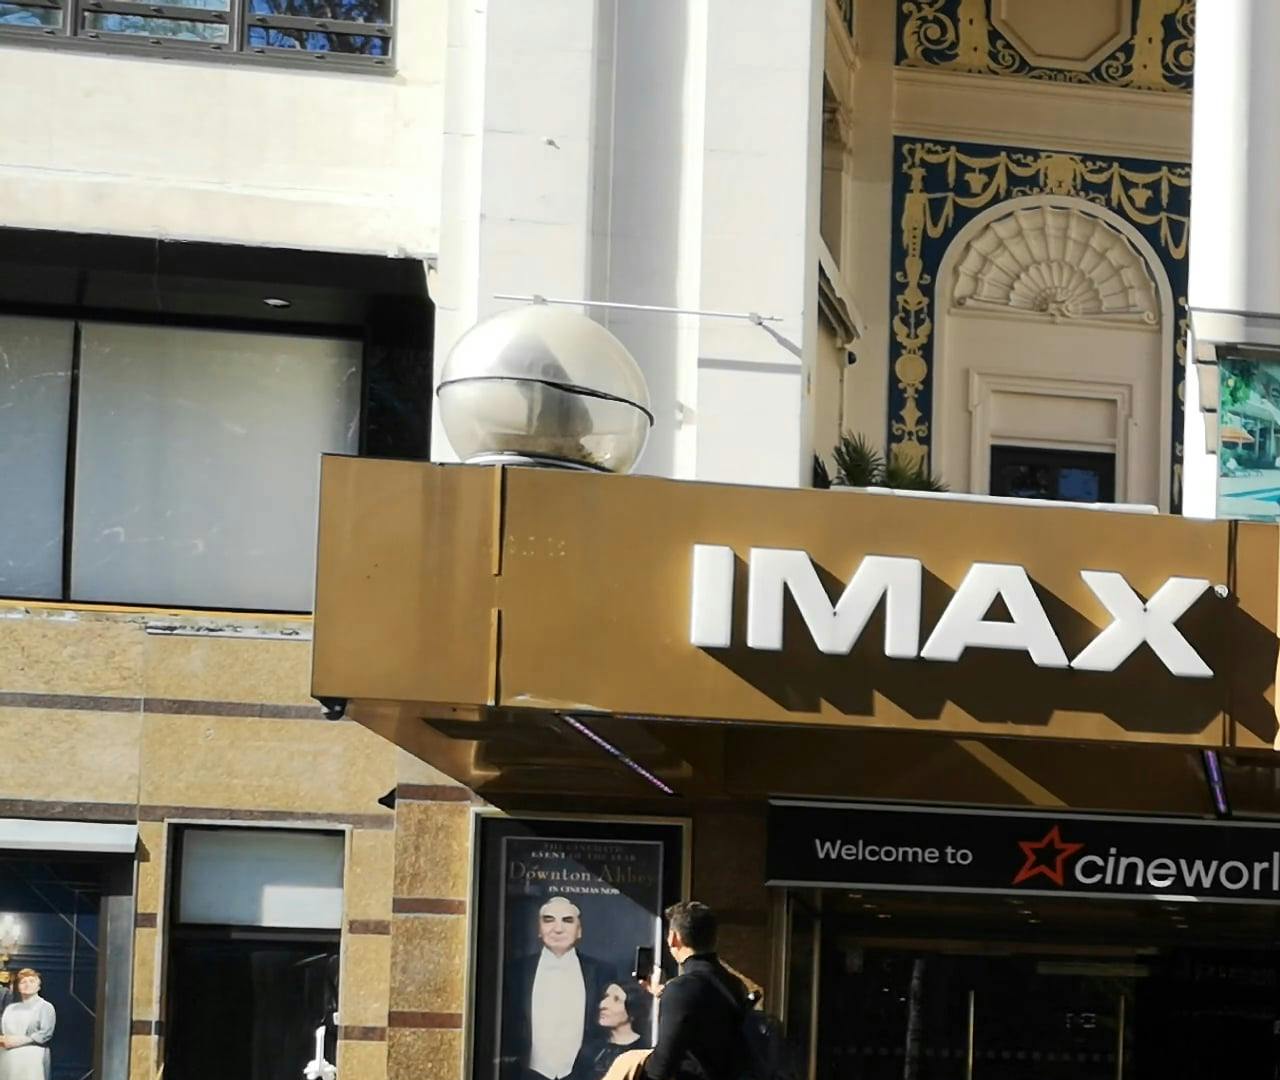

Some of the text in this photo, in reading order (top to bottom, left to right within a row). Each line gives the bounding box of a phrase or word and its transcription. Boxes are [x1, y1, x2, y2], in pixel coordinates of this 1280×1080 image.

[690, 543, 1215, 678] IMAX
[814, 838, 973, 866] Welcome to
[510, 861, 591, 881] Downton
